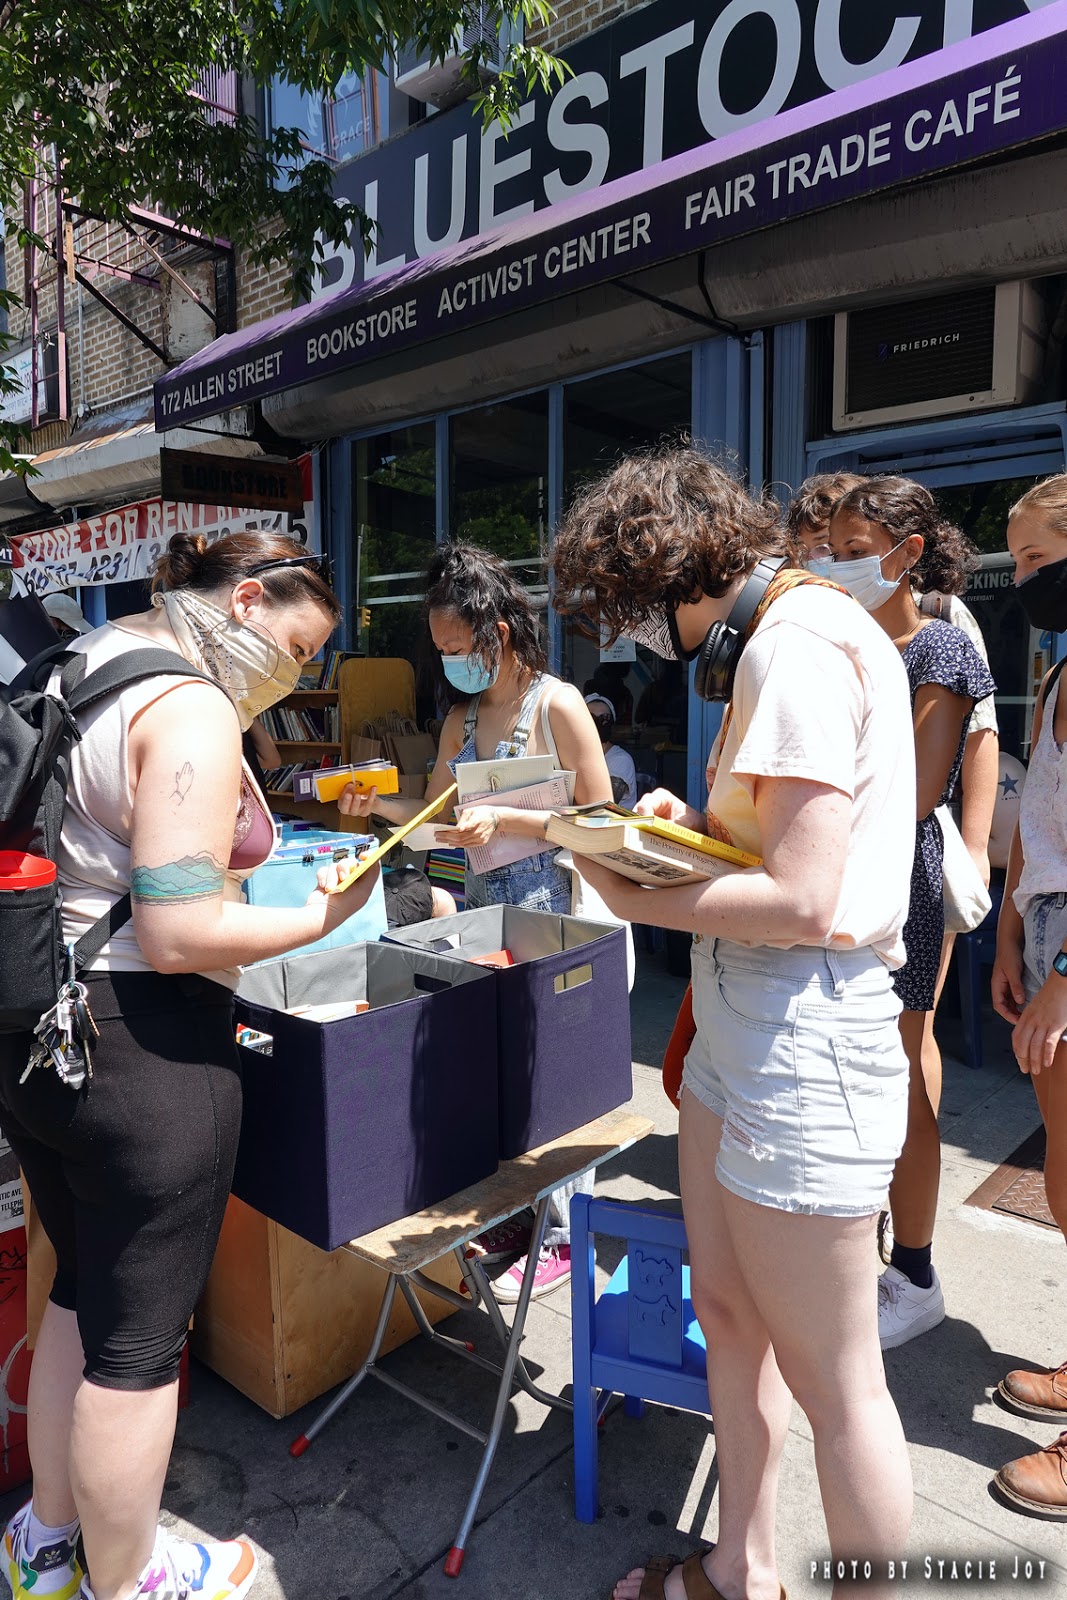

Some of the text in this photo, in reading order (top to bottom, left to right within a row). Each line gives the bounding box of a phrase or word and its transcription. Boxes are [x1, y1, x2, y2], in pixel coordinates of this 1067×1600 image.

[161, 65, 1022, 415] 172 ALLEN STREET BOOKSTORE ACTIVIST CENTER FAIR TRADE CAFÉ
[893, 333, 960, 353] FRIEDRICH
[19, 523, 81, 562] STORE
[86, 508, 138, 554] FOR
[147, 501, 206, 539] RENT
[649, 838, 660, 847] The
[661, 841, 684, 856] Poverty
[685, 849, 692, 858] of
[692, 852, 718, 868] Progress
[0, 1191, 10, 1200] TIC
